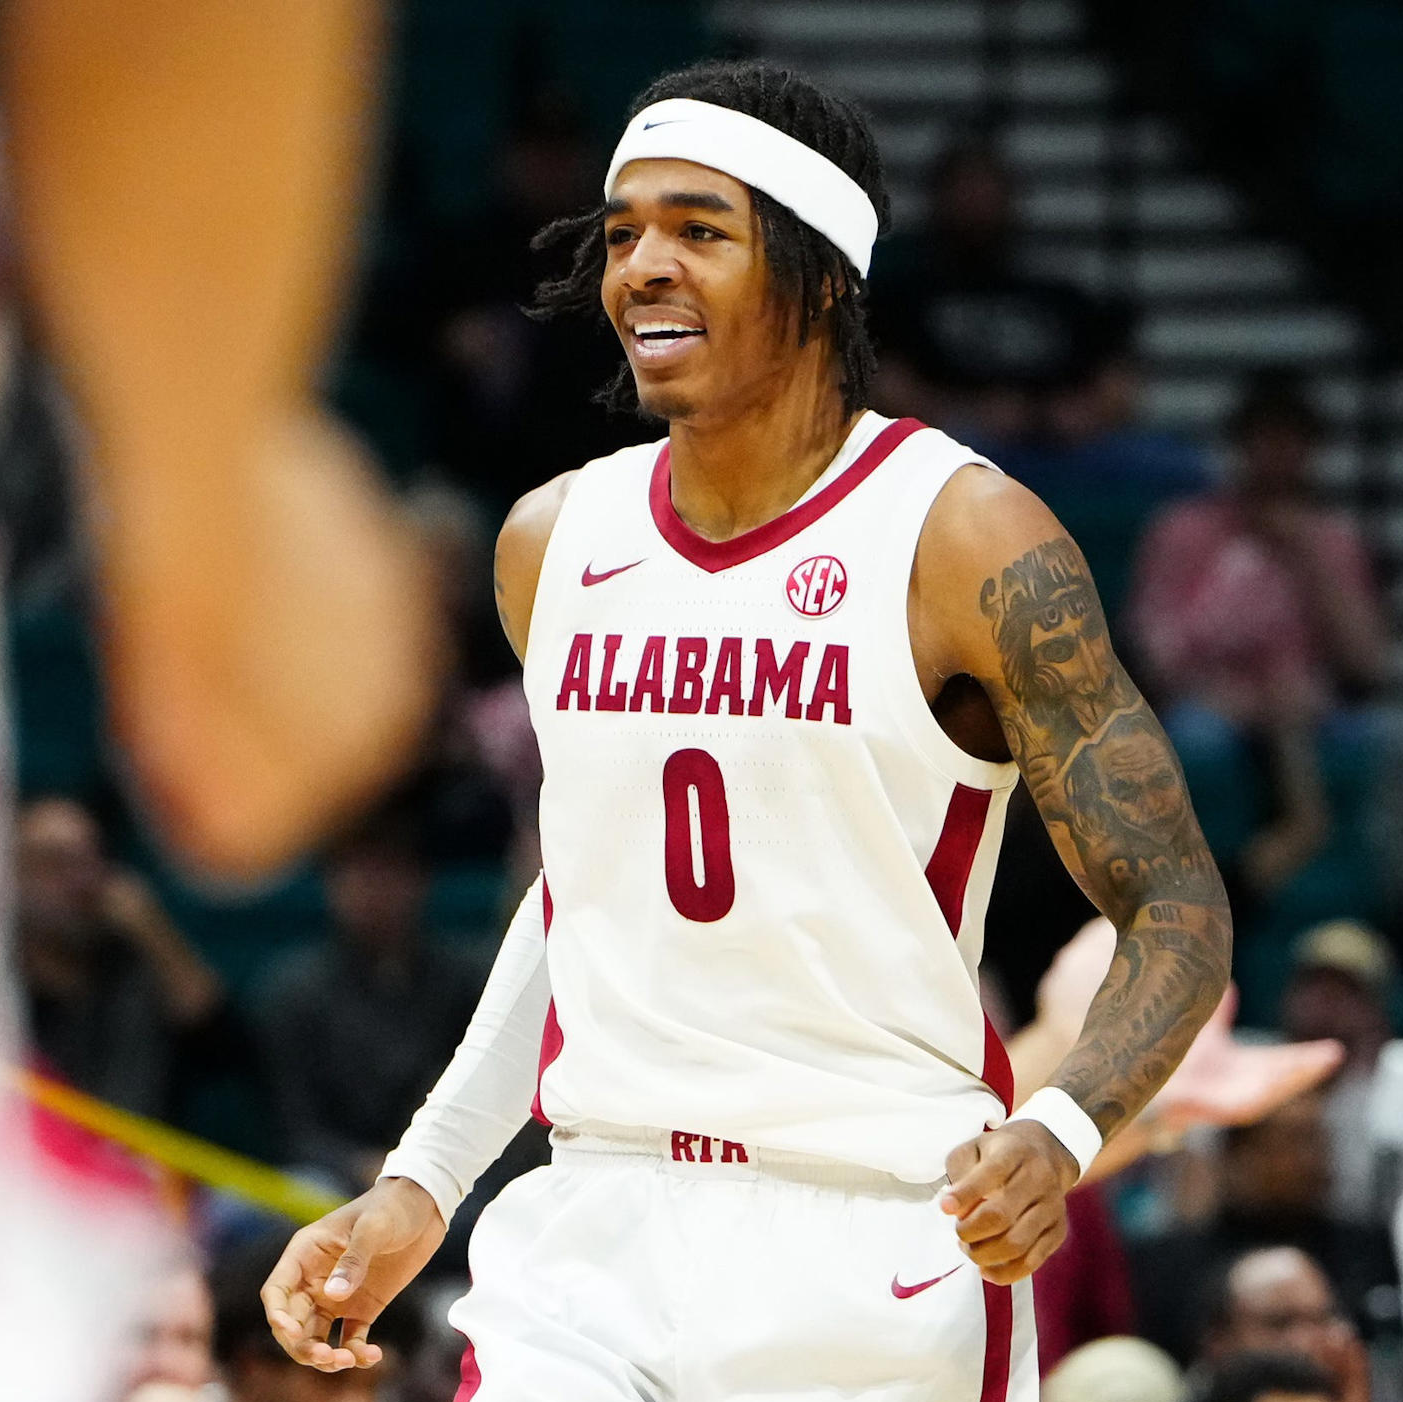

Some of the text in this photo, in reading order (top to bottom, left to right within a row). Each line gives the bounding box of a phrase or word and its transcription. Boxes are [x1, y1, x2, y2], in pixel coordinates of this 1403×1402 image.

[786, 555, 847, 615] SEC
[556, 633, 852, 726] ALABAMA
[663, 747, 736, 922] 0
